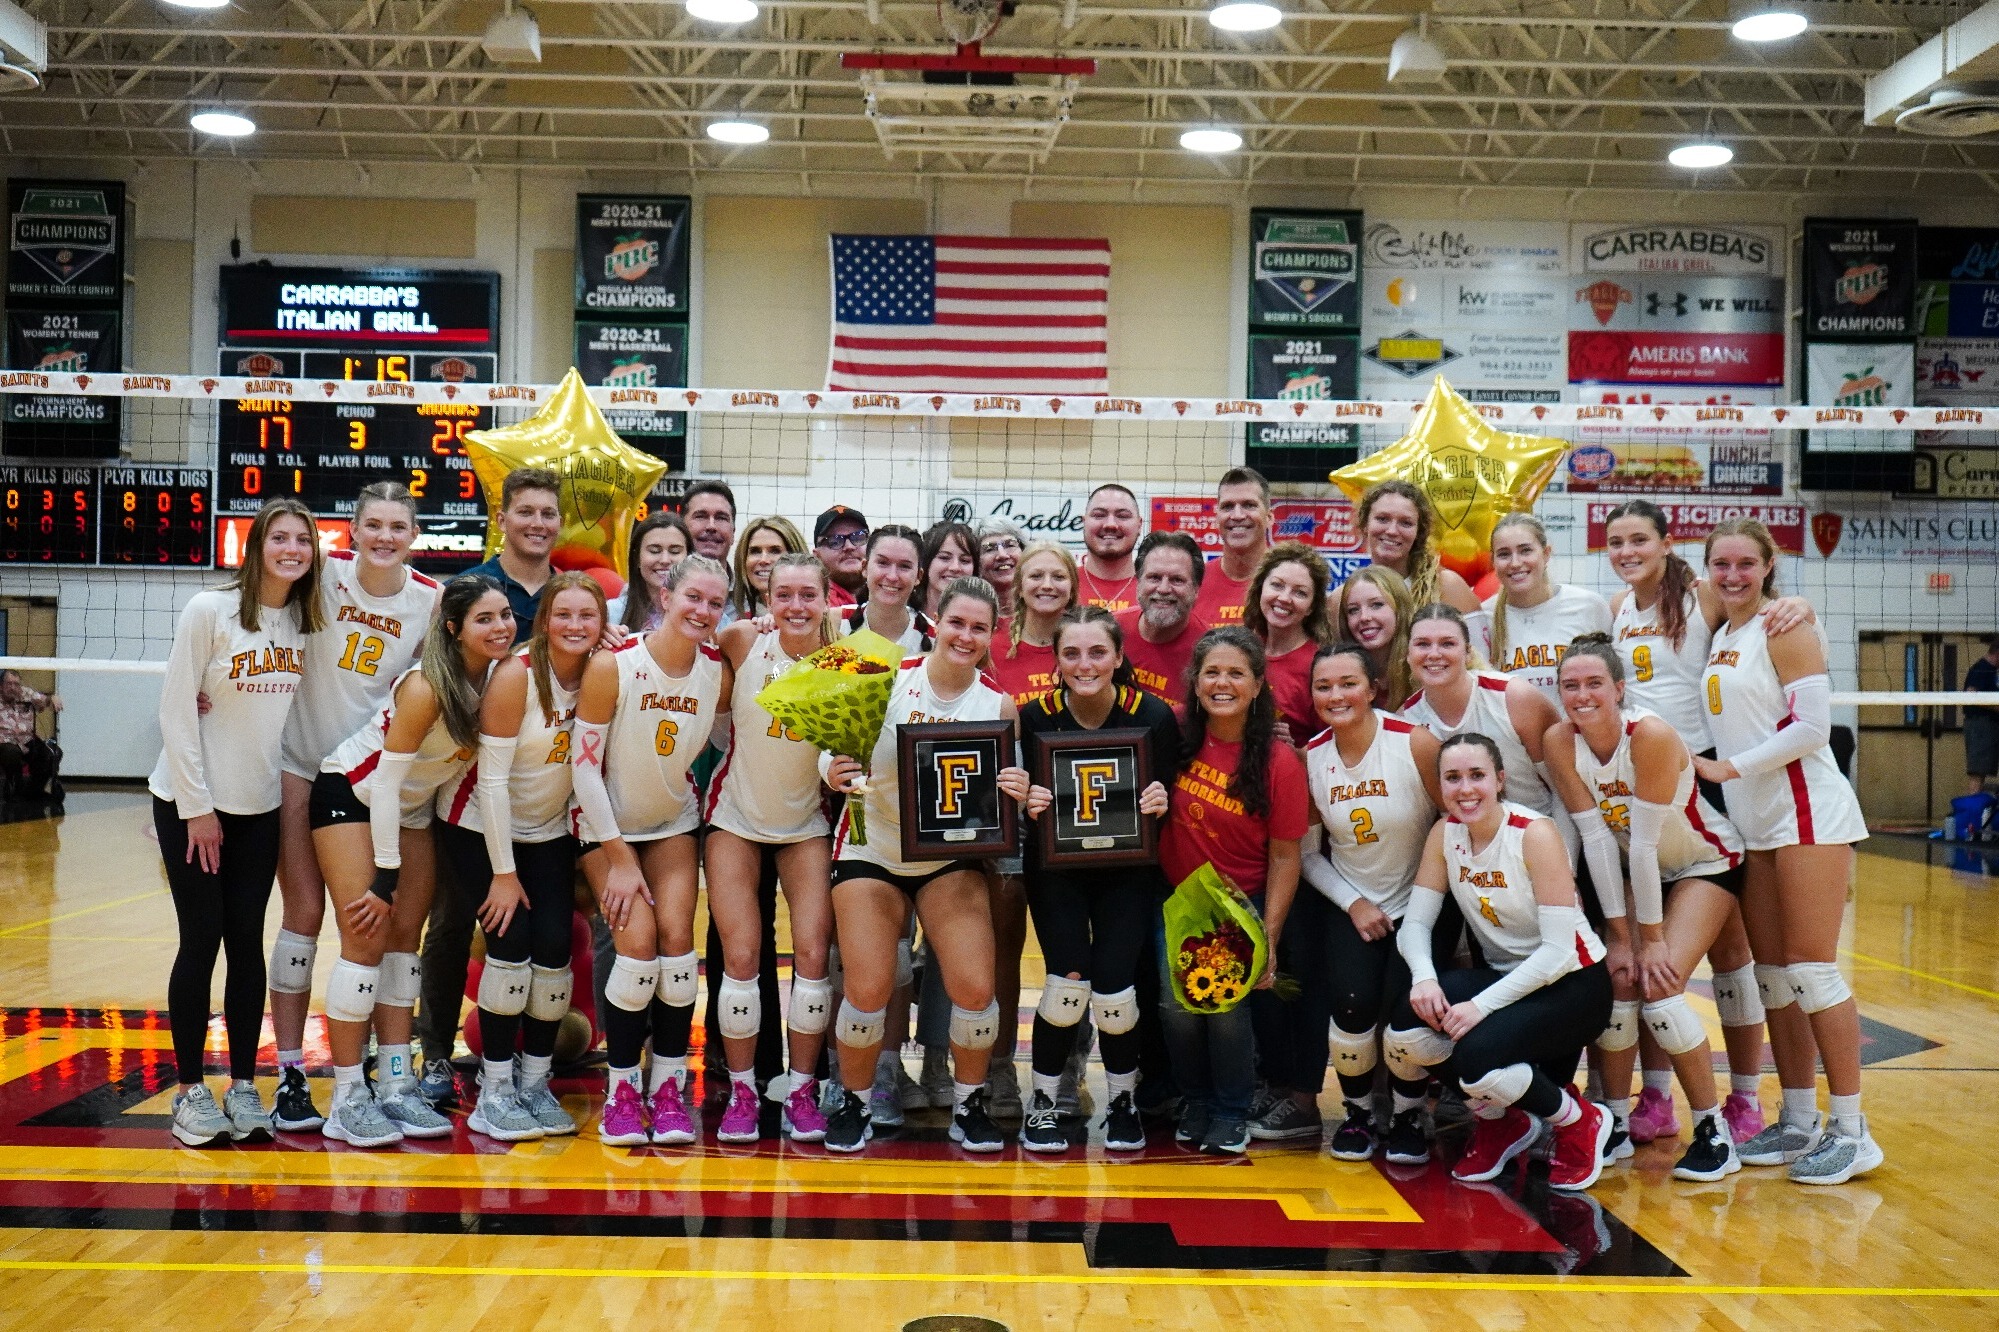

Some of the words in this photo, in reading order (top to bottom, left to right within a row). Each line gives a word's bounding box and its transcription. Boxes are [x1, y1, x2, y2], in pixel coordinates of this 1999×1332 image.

[49, 198, 81, 208] 2021
[601, 204, 662, 218] 2020-21
[20, 223, 108, 241] CHAMPIONS
[1843, 230, 1878, 243] 2021
[1589, 230, 1767, 264] CARRABBA'S
[1264, 253, 1349, 269] CHAMPIONS
[9, 283, 49, 294] WOMEN'S
[50, 284, 77, 295] CROSS
[78, 285, 115, 296] COUNTRY
[281, 283, 420, 308] CARRABBA'S
[1459, 285, 1488, 305] kw
[585, 292, 676, 309] CHAMPIONS
[1699, 298, 1726, 312] WE
[1732, 298, 1776, 313] WILL
[42, 315, 79, 329] 2021
[277, 308, 361, 331] ITALIAN
[373, 311, 439, 333] GRILL
[1817, 316, 1906, 331] CHAMPIONS
[23, 329, 66, 339] WOMEN'S
[68, 330, 100, 340] TENNIS
[599, 327, 661, 342] 2020-21
[1285, 340, 1322, 354] 2021
[1628, 345, 1696, 363] AMERIS
[1700, 346, 1750, 364] BANK
[0, 373, 49, 388] SAINTS
[122, 376, 171, 392] SAINTS
[244, 380, 293, 395] SAINTS
[366, 384, 415, 398] SAINTS
[488, 387, 536, 401] SAINTS
[610, 389, 658, 405] SAINTS
[731, 392, 779, 408] SAINTS
[852, 394, 900, 410] SAINTS
[973, 396, 1021, 412] SAINTS
[1094, 399, 1142, 415] SAINTS
[14, 403, 105, 420] CHAMPIONS
[336, 405, 375, 419] PERIOD
[1215, 401, 1263, 417] SAINTS
[1335, 403, 1383, 418] SAINTS
[1475, 405, 1504, 420] NTS
[1576, 405, 1624, 420] SAINTS
[1696, 407, 1744, 422] SAINTS
[1815, 408, 1864, 424] SAINTS
[1935, 408, 1983, 424] SAINTS
[608, 416, 674, 432] AMPIONS
[260, 416, 293, 450] 17
[349, 421, 367, 450] 3
[1260, 428, 1349, 443] CHAMPIONS
[230, 452, 266, 466] FOULS
[277, 454, 306, 467] T.O.L.
[318, 454, 360, 468] PLAYER
[364, 455, 392, 469] FOUL
[402, 455, 432, 469] T.O.L.
[445, 456, 473, 469] FOUL
[1709, 446, 1759, 463] LUNCH
[24, 468, 57, 484] KILLS
[63, 468, 91, 485] DIGS
[104, 470, 135, 486] PLYR
[141, 470, 174, 486] KILLS
[180, 471, 208, 487] DIGS
[243, 466, 262, 494] 0
[294, 469, 302, 493] 1
[1714, 464, 1769, 485] DINNER
[408, 469, 428, 497] 2
[459, 470, 475, 498] 3
[7, 490, 19, 509] 0
[43, 490, 54, 510] 3
[74, 491, 86, 511] 5
[124, 492, 136, 511] 8
[158, 492, 171, 512] 0
[190, 493, 204, 512] 5
[443, 502, 478, 515] SCORE
[1325, 508, 1351, 520] Five
[1848, 516, 1940, 541] SAINTS
[1947, 517, 1997, 541] CLU
[1322, 532, 1356, 545] Pizza
[336, 605, 402, 638] FLAGLER
[337, 631, 385, 677] 12
[229, 646, 304, 680] FLAGL
[1632, 645, 1654, 683] 9
[236, 682, 297, 694] VOLLEYB
[640, 692, 699, 715] FLAGLER
[655, 719, 679, 757] 6
[545, 730, 572, 765] 2
[1190, 760, 1229, 790] TEAM
[934, 750, 981, 819] F
[1071, 758, 1120, 827] F
[1329, 779, 1389, 805] FLAGLER
[1176, 775, 1244, 816] MOREAUX
[1349, 807, 1380, 846] 2
